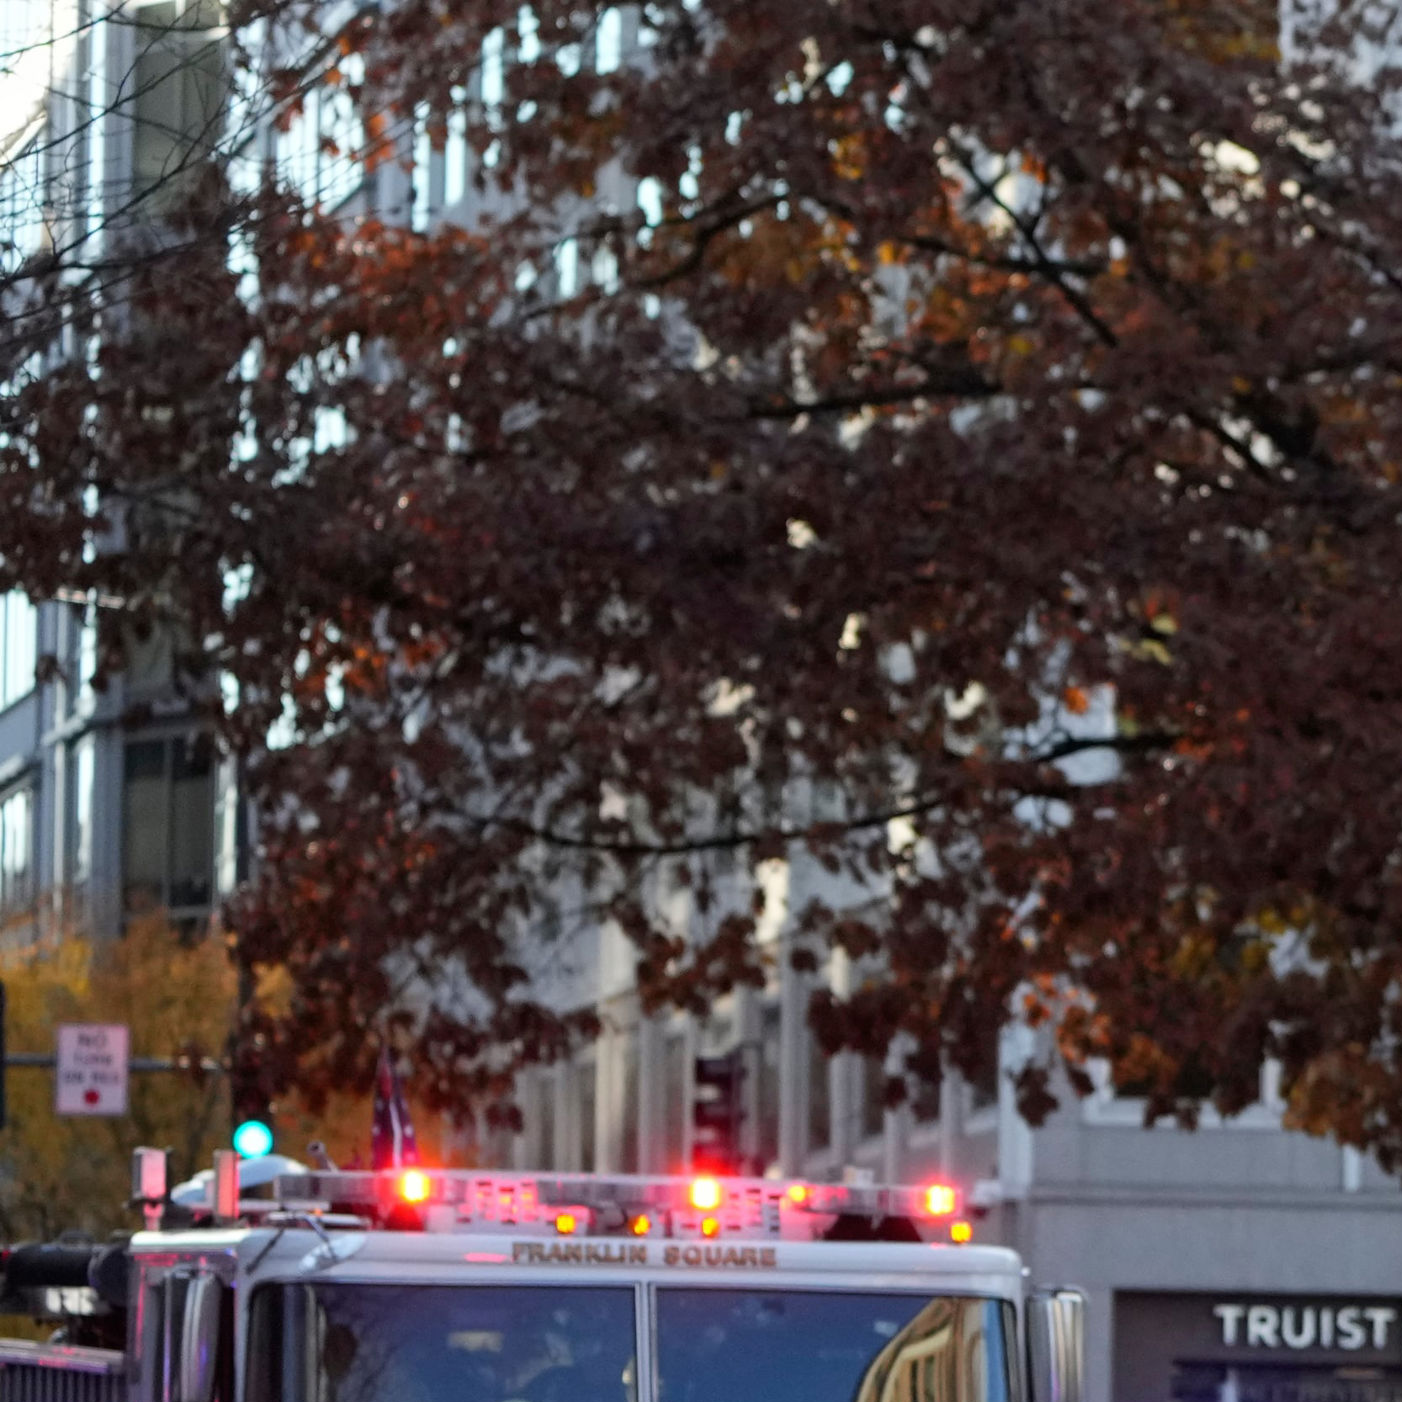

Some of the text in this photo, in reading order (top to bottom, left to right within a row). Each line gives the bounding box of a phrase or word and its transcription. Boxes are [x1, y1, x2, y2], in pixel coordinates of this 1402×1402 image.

[512, 1242, 777, 1267] FRANKLIN SQUARE
[1213, 1303, 1397, 1350] TRUIST
